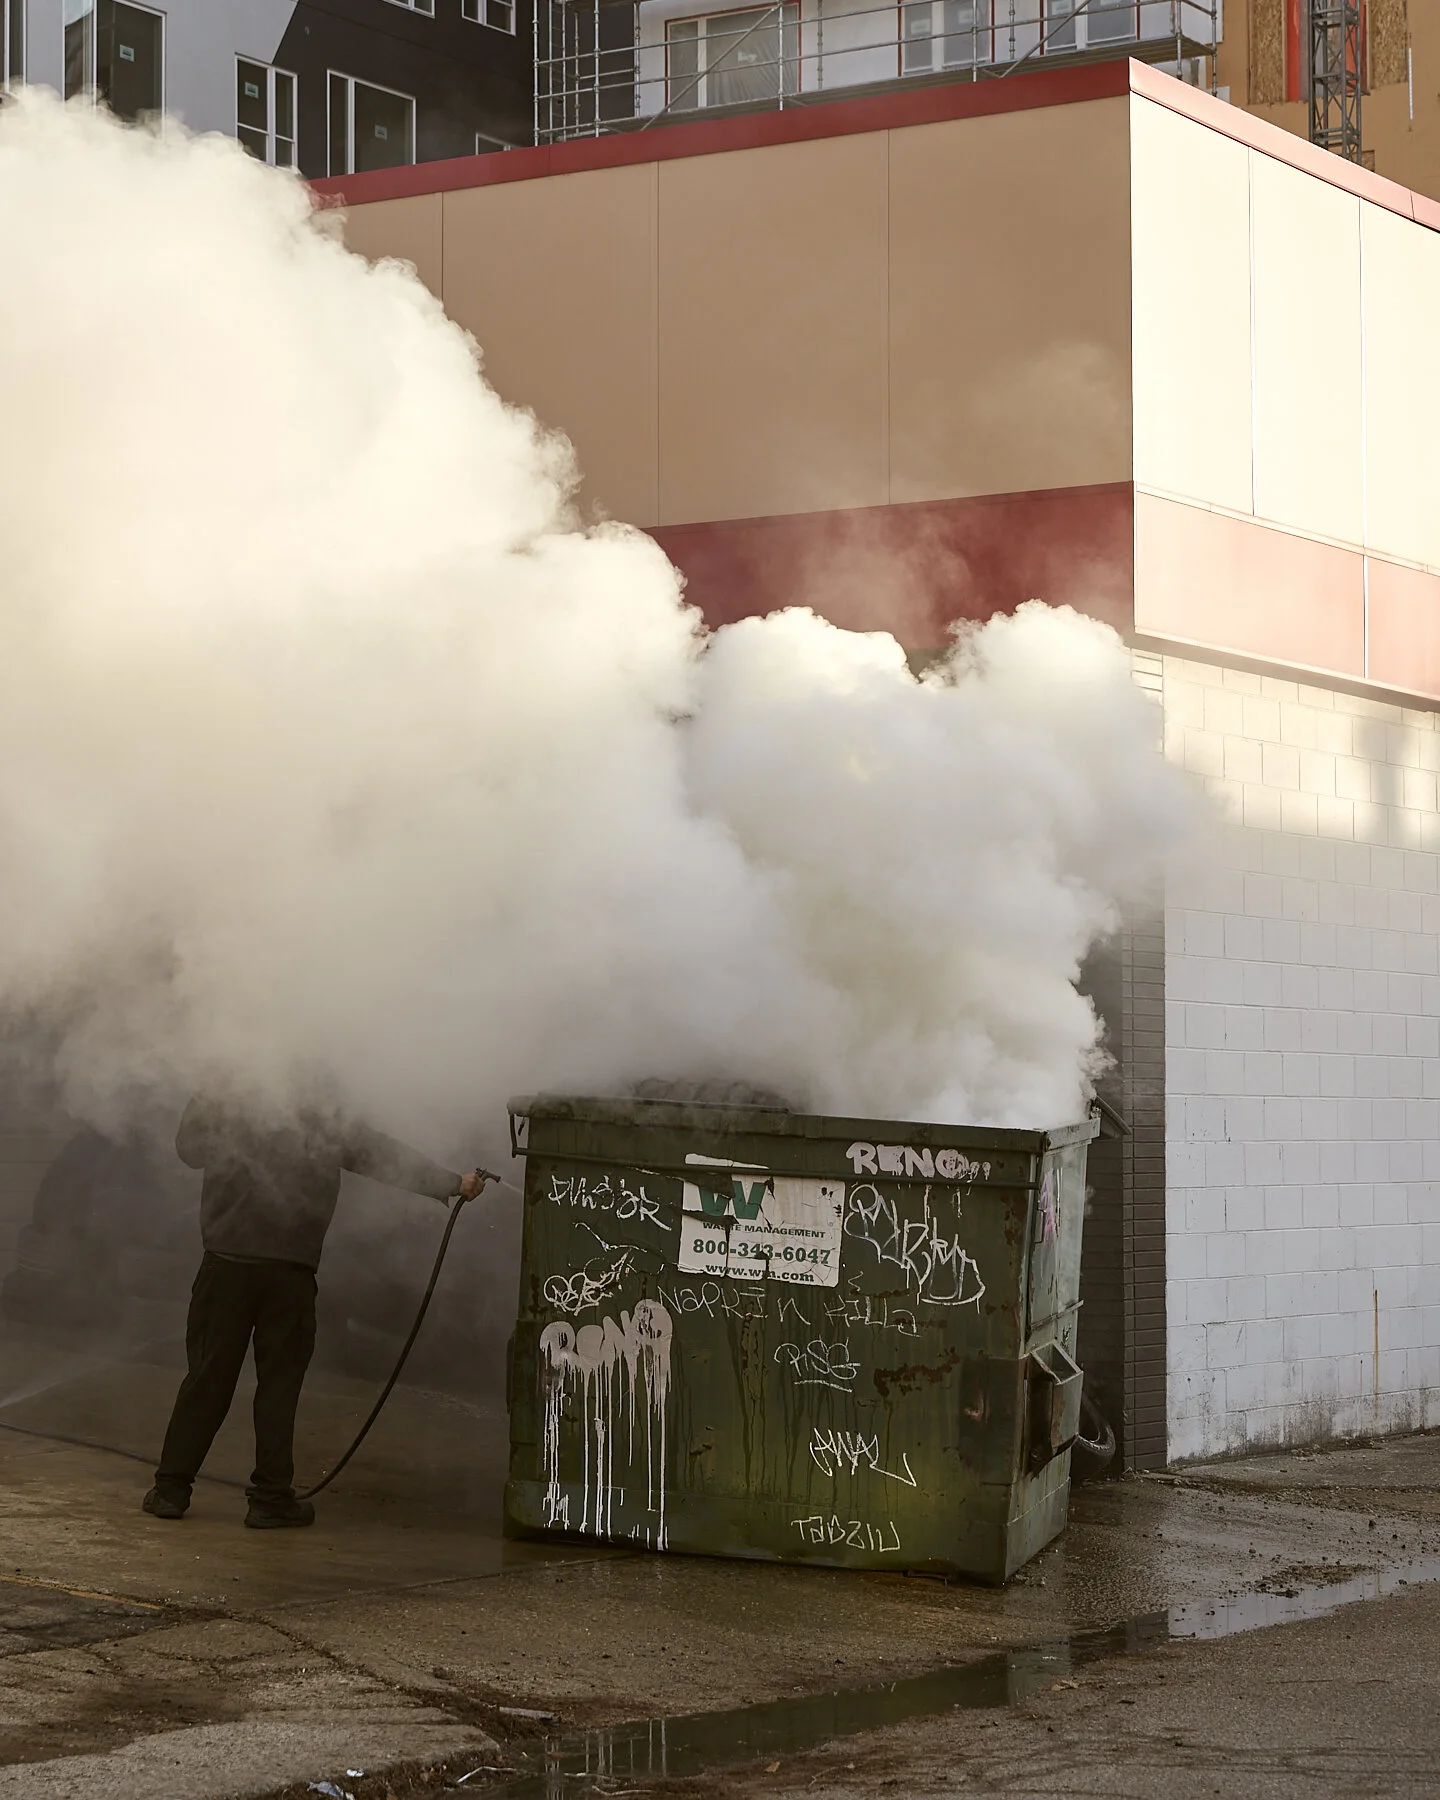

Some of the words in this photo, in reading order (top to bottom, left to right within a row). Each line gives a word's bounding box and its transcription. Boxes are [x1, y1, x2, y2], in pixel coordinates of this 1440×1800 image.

[745, 1225, 826, 1239] MANAGEMENT
[693, 1239, 831, 1265] 800-343-6047
[705, 1264, 815, 1282] www.wm.com
